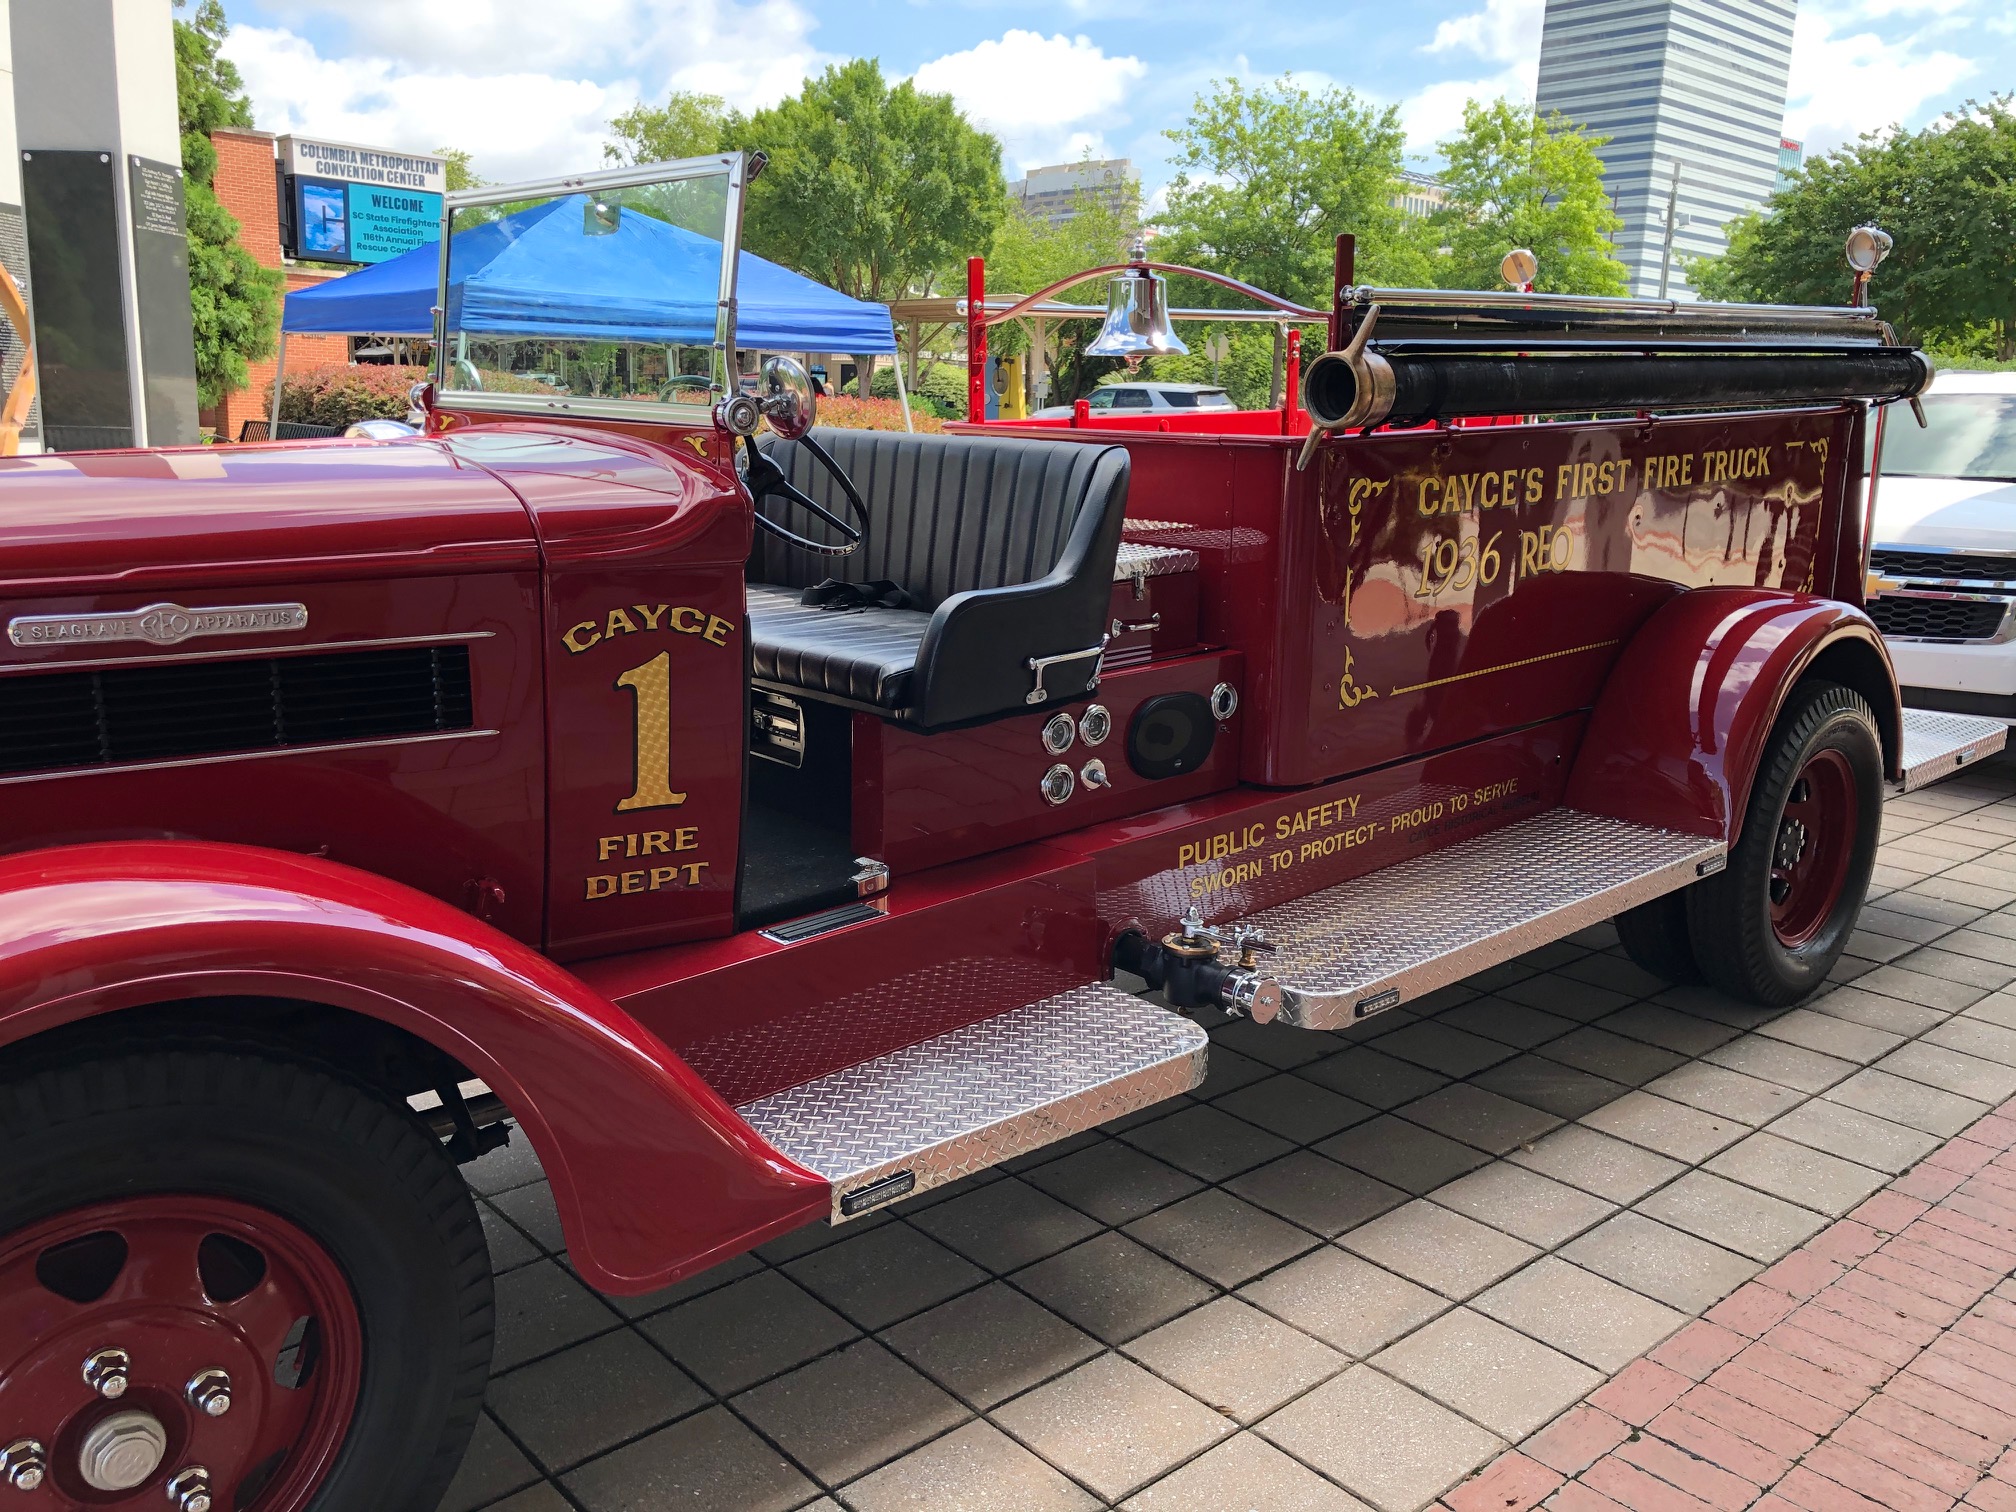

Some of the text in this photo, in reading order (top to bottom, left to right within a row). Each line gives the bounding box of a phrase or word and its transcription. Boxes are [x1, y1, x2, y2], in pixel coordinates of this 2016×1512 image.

[300, 143, 439, 175] COLUMBIA METROPOLITAN
[316, 160, 425, 187] CONVENTION CENTER
[371, 194, 424, 213] WELCOME
[352, 211, 440, 229] SC State Firefighters
[373, 224, 424, 237] Association
[356, 242, 388, 252] Rescue
[363, 233, 432, 247] 116th Annual Fir
[1418, 446, 1772, 518] CAYCE'S FIRST FIRE TRUCK
[1414, 524, 1574, 598] 1936 REO
[31, 621, 133, 640] SEAGRAVE
[193, 610, 292, 631] APPARATUS
[560, 603, 736, 655] CAYCE
[612, 650, 688, 815] 1
[598, 826, 700, 862] FIRE
[1178, 794, 1362, 870] PUBLIC SAFETY
[1190, 859, 1263, 899] SWORN
[1269, 848, 1294, 872] TO
[1391, 801, 1444, 834] PROUD
[1449, 793, 1468, 814] TO
[1473, 777, 1519, 806] SERVE
[1409, 823, 1441, 844] CAYCE
[585, 861, 710, 901] DEPT
